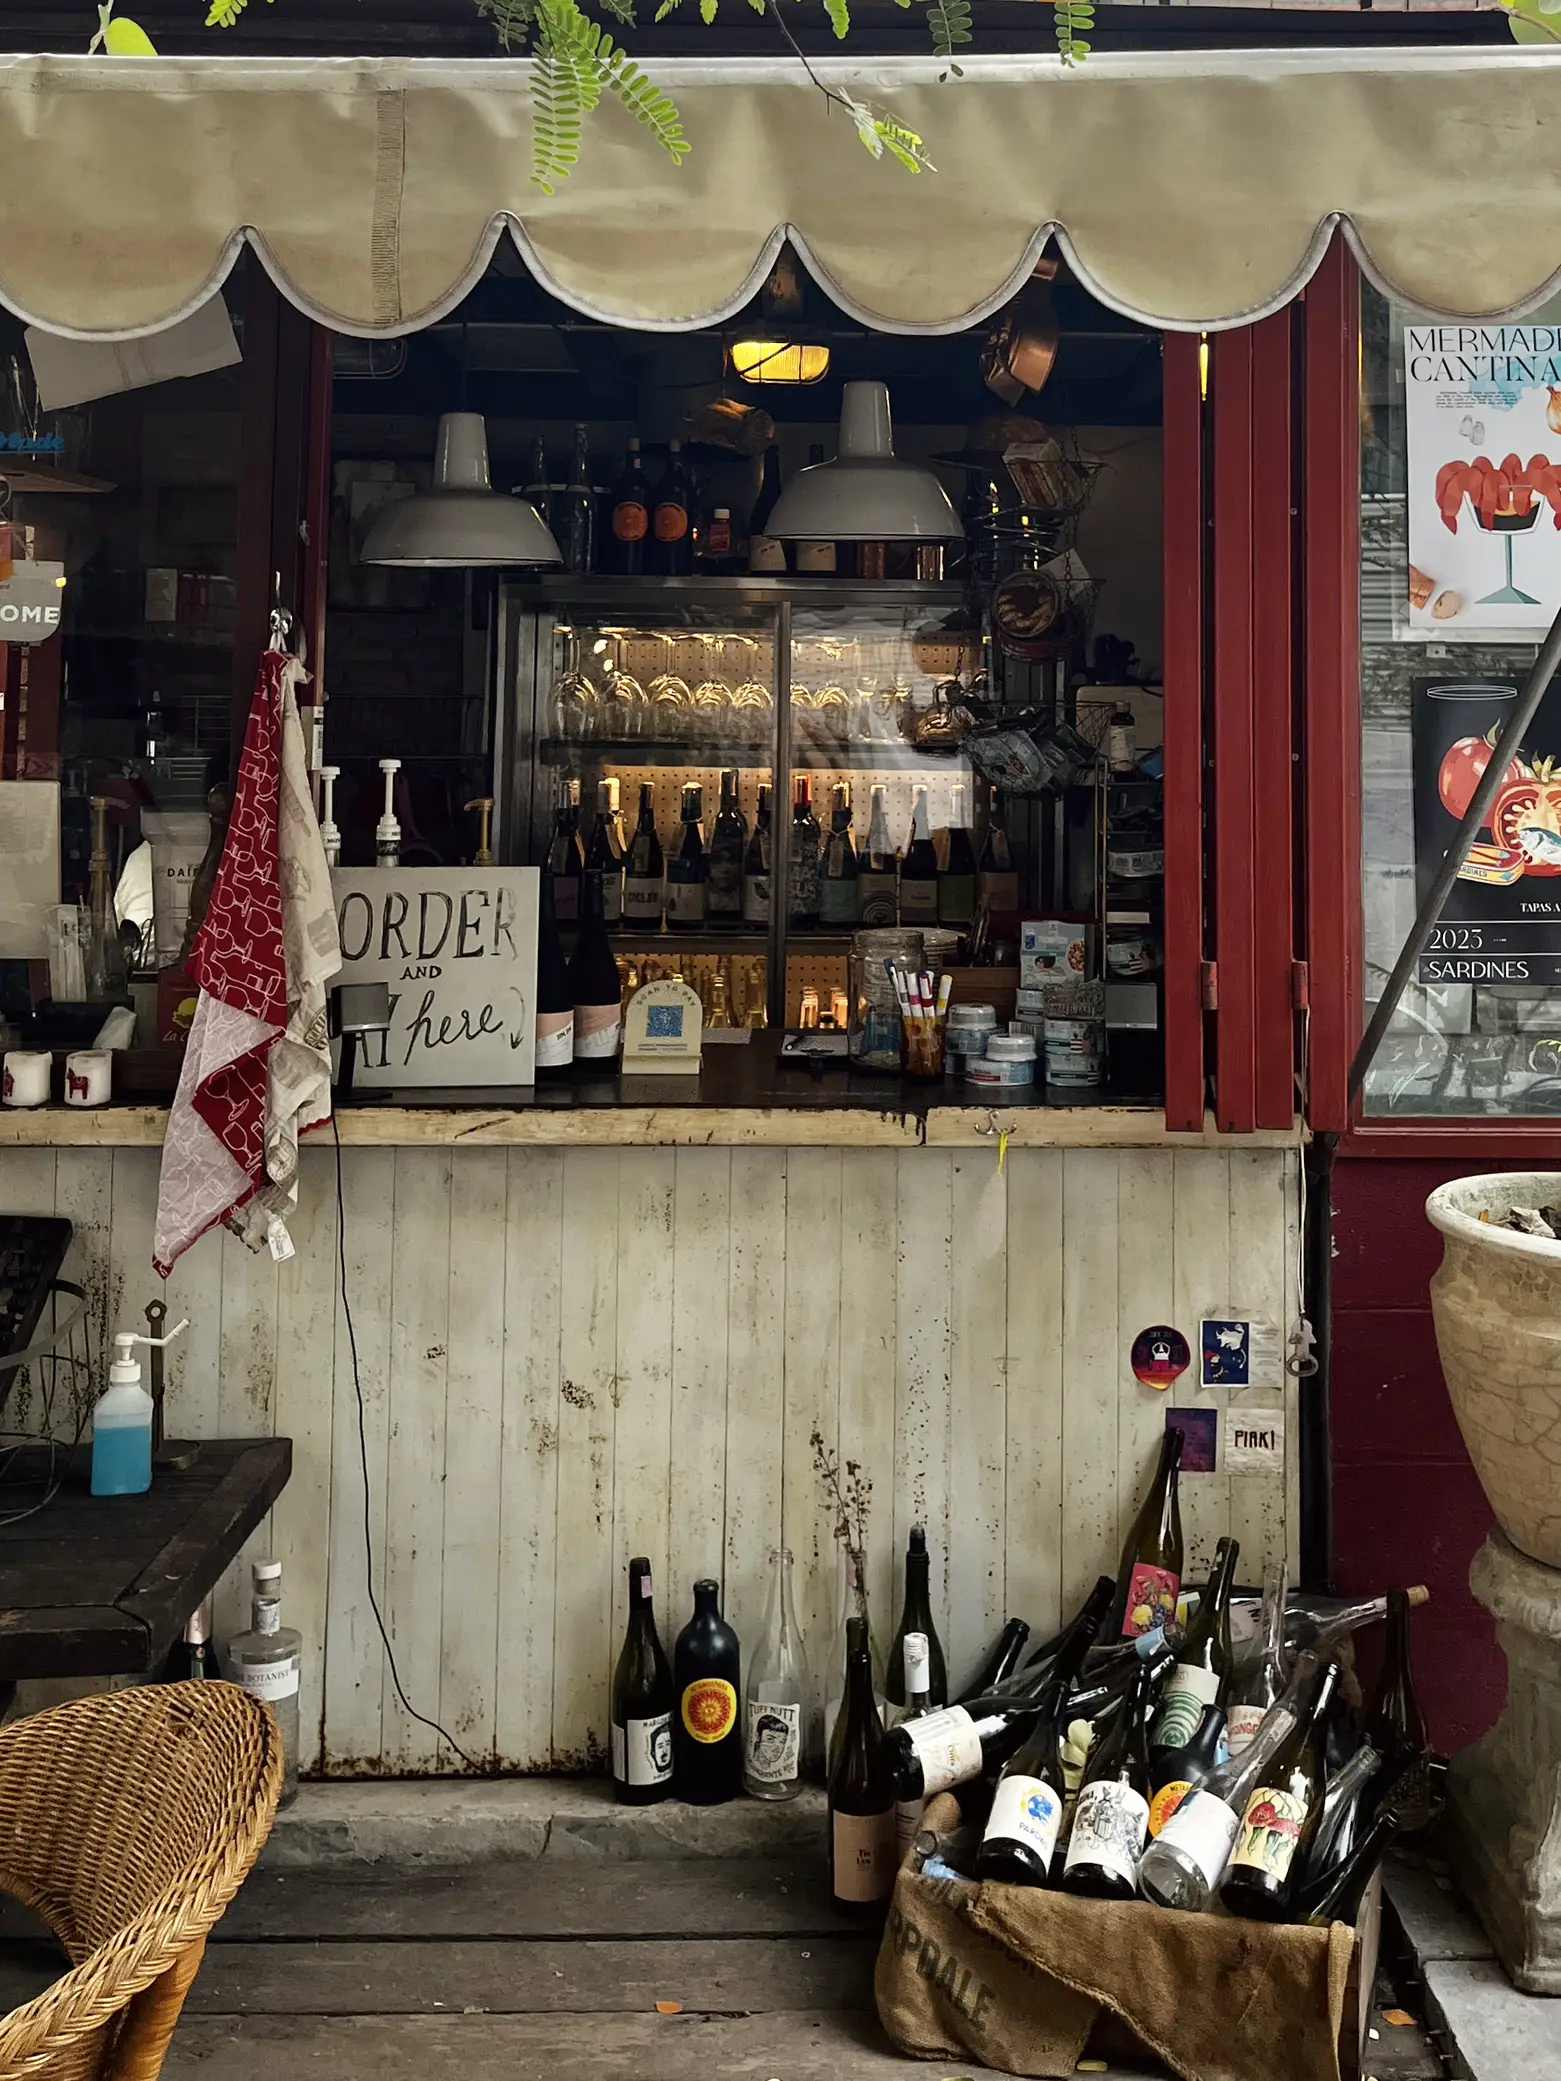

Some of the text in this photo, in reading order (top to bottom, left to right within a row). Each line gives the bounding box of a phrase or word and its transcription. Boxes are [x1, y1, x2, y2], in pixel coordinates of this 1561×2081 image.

[1410, 328, 1561, 352] MERMAD
[1411, 356, 1561, 381] CANTINA
[1520, 902, 1551, 912] TAPAS
[339, 887, 518, 960] ORDER
[1429, 929, 1483, 949] 2023
[400, 965, 443, 980] AND
[1429, 961, 1529, 978] SARDINES
[403, 989, 503, 1066] here
[247, 1669, 289, 1681] BOTANIST
